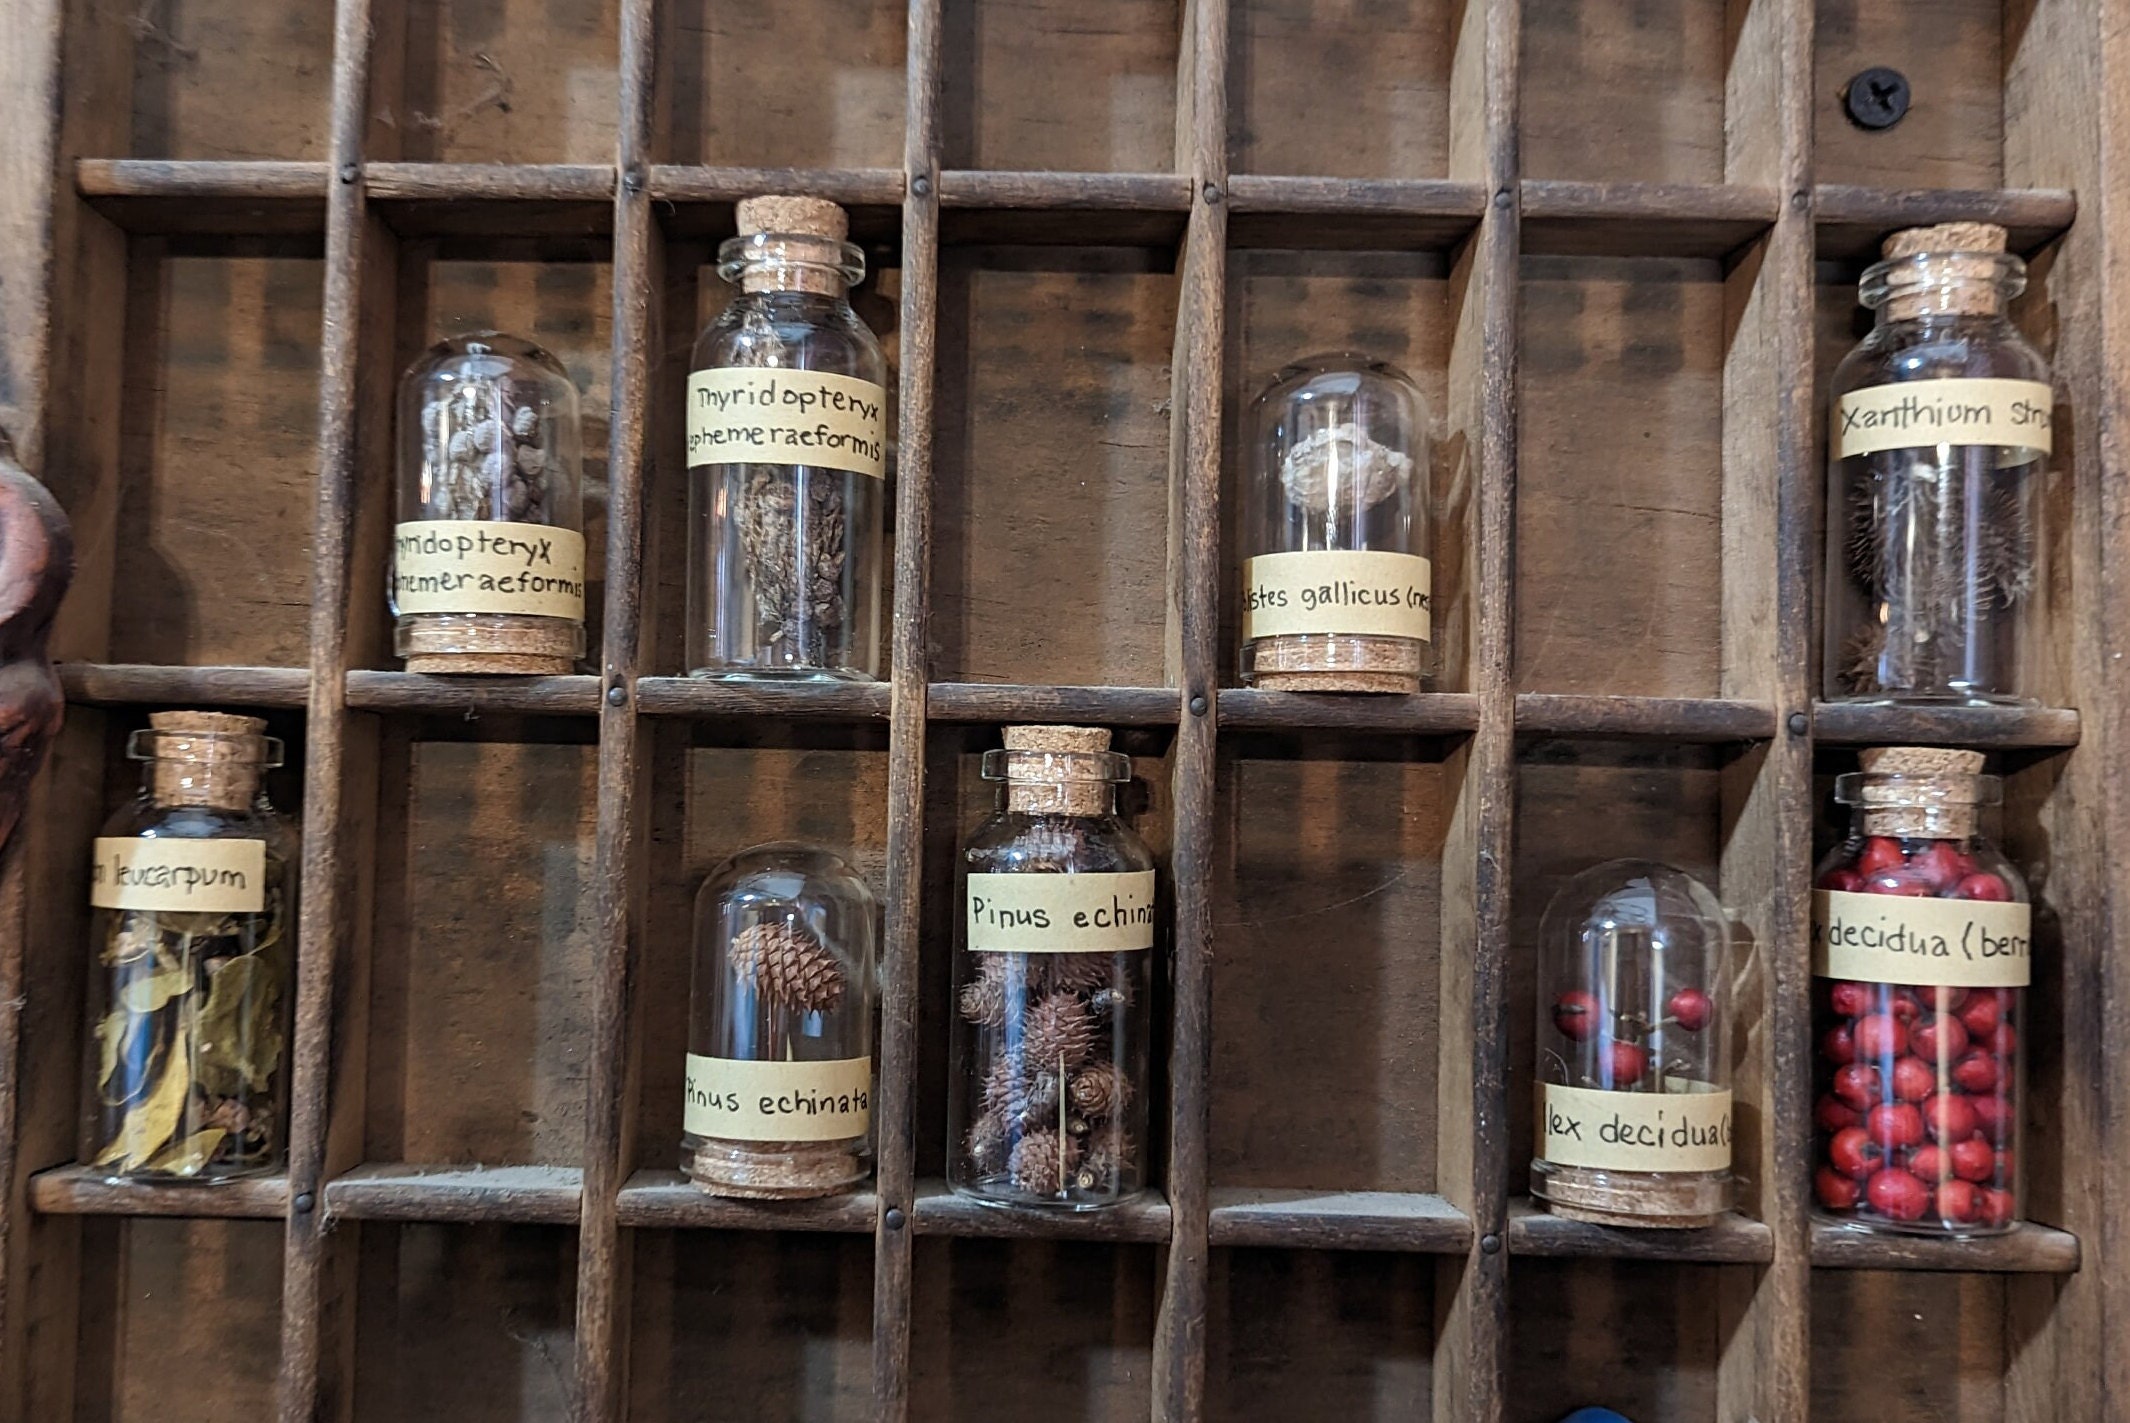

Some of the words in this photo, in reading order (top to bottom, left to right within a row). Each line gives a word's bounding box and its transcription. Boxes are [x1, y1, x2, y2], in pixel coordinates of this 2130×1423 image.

[697, 379, 879, 422] Thyridopteryx
[1840, 396, 1991, 436] Xanthium
[396, 568, 582, 598] hemeraeformis
[1301, 580, 1400, 611] gallicus
[972, 896, 1051, 929] Pinus
[1828, 916, 1951, 957] decidua
[686, 1077, 740, 1112] Pinus
[758, 1088, 868, 1115] echinata
